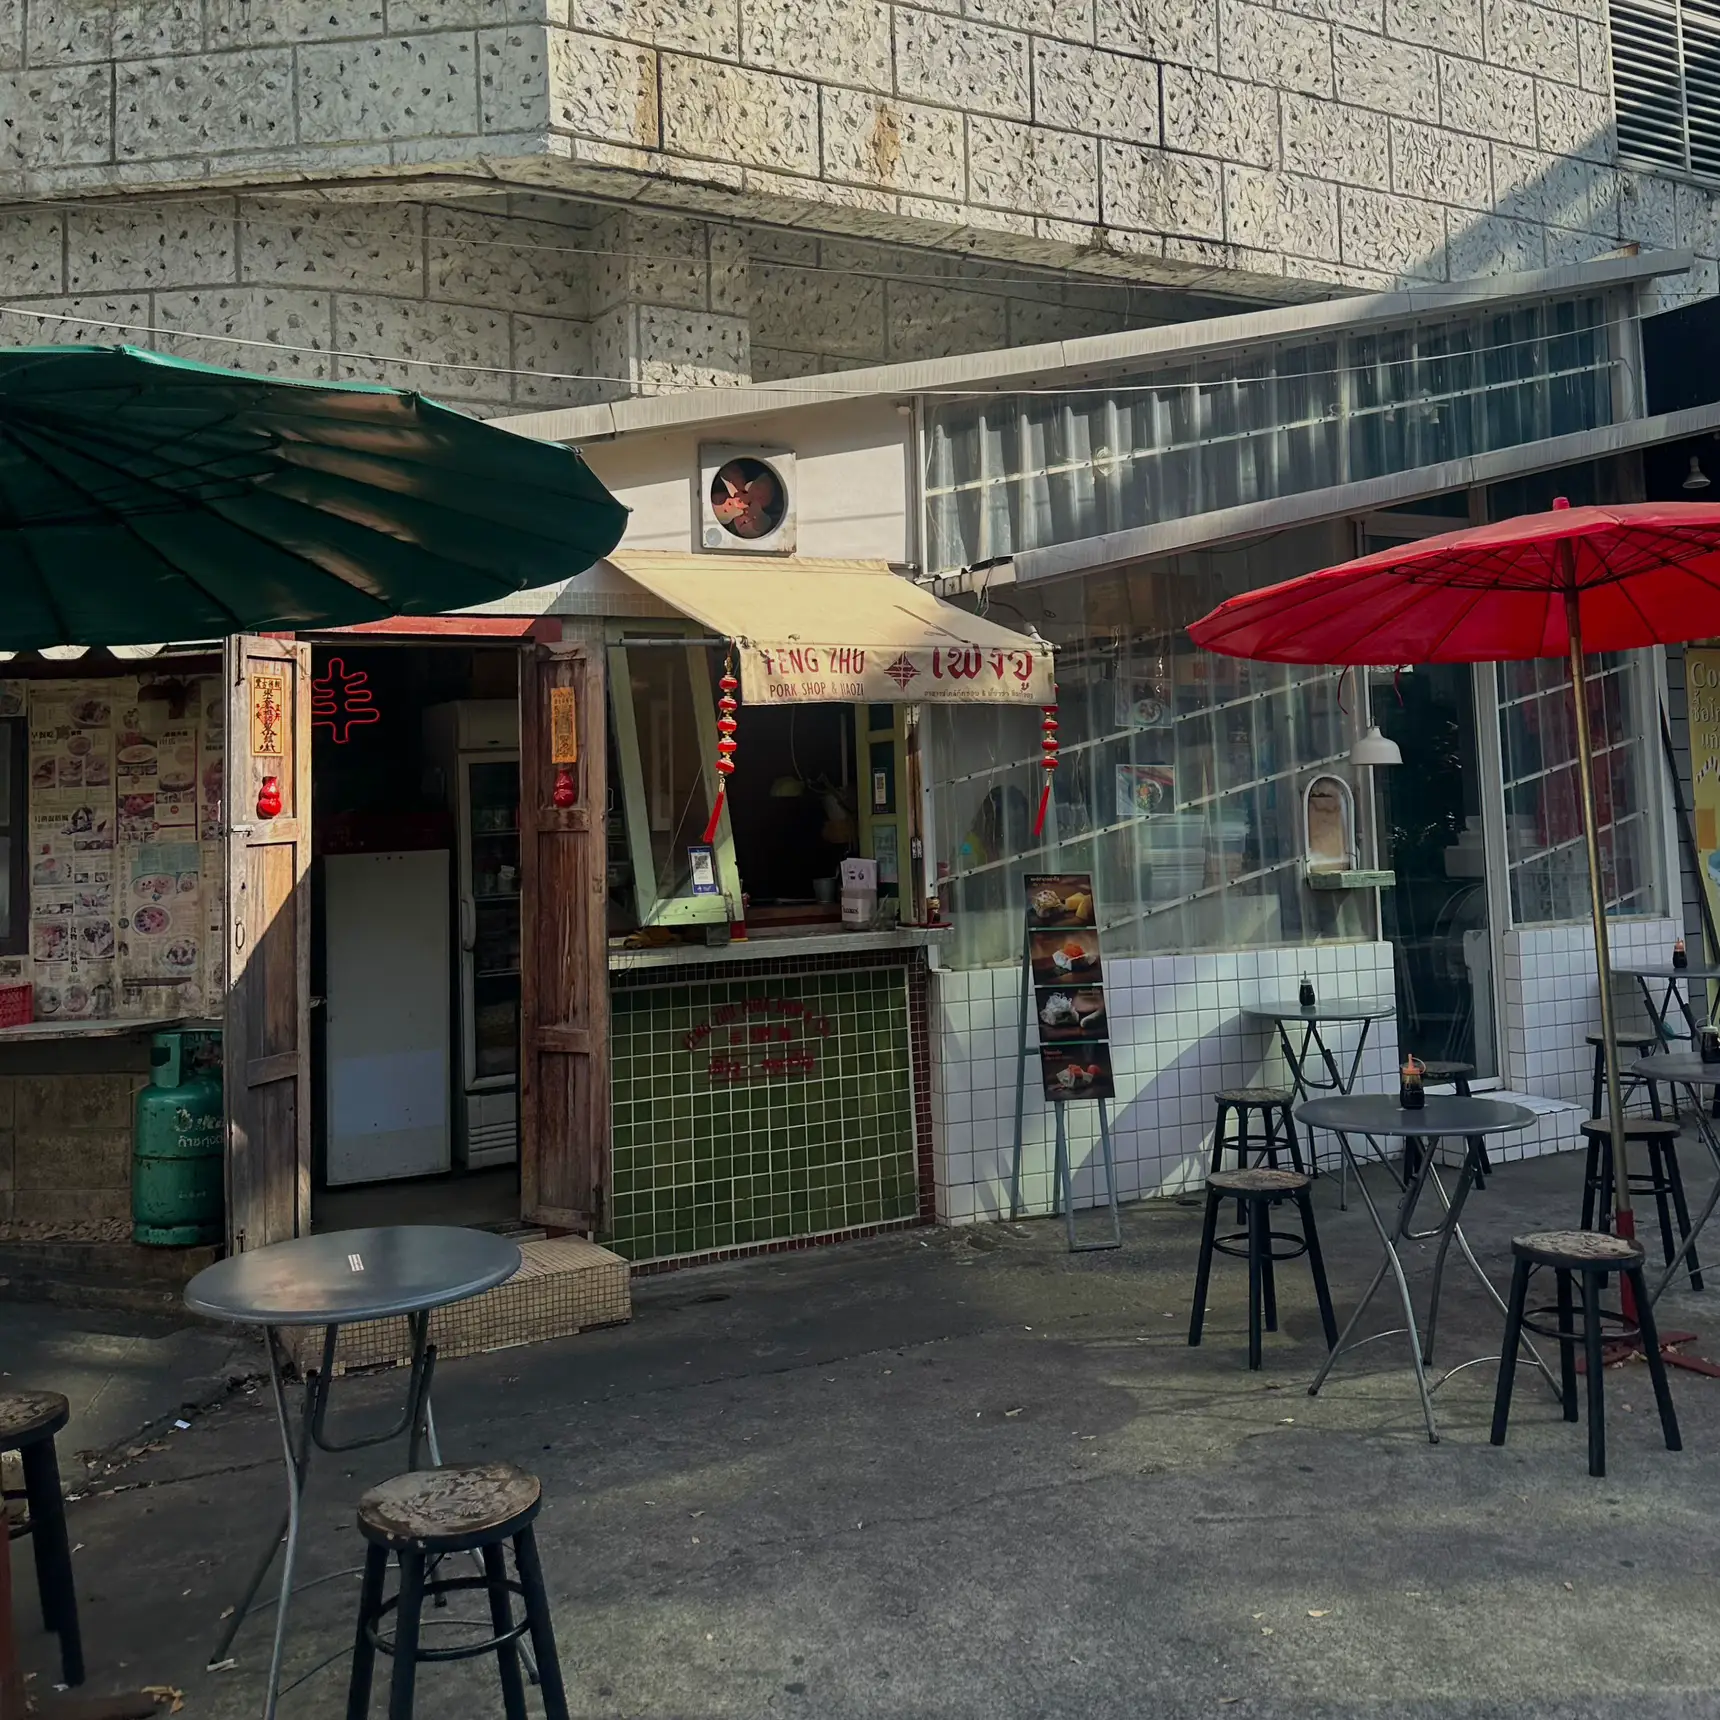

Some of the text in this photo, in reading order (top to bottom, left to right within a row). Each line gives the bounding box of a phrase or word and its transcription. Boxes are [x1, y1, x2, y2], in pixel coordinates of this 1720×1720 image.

[829, 647, 866, 675] ZHU
[1691, 661, 1720, 688] Co
[769, 683, 797, 698] PORK
[802, 681, 826, 697] SHOP
[831, 682, 838, 694] &
